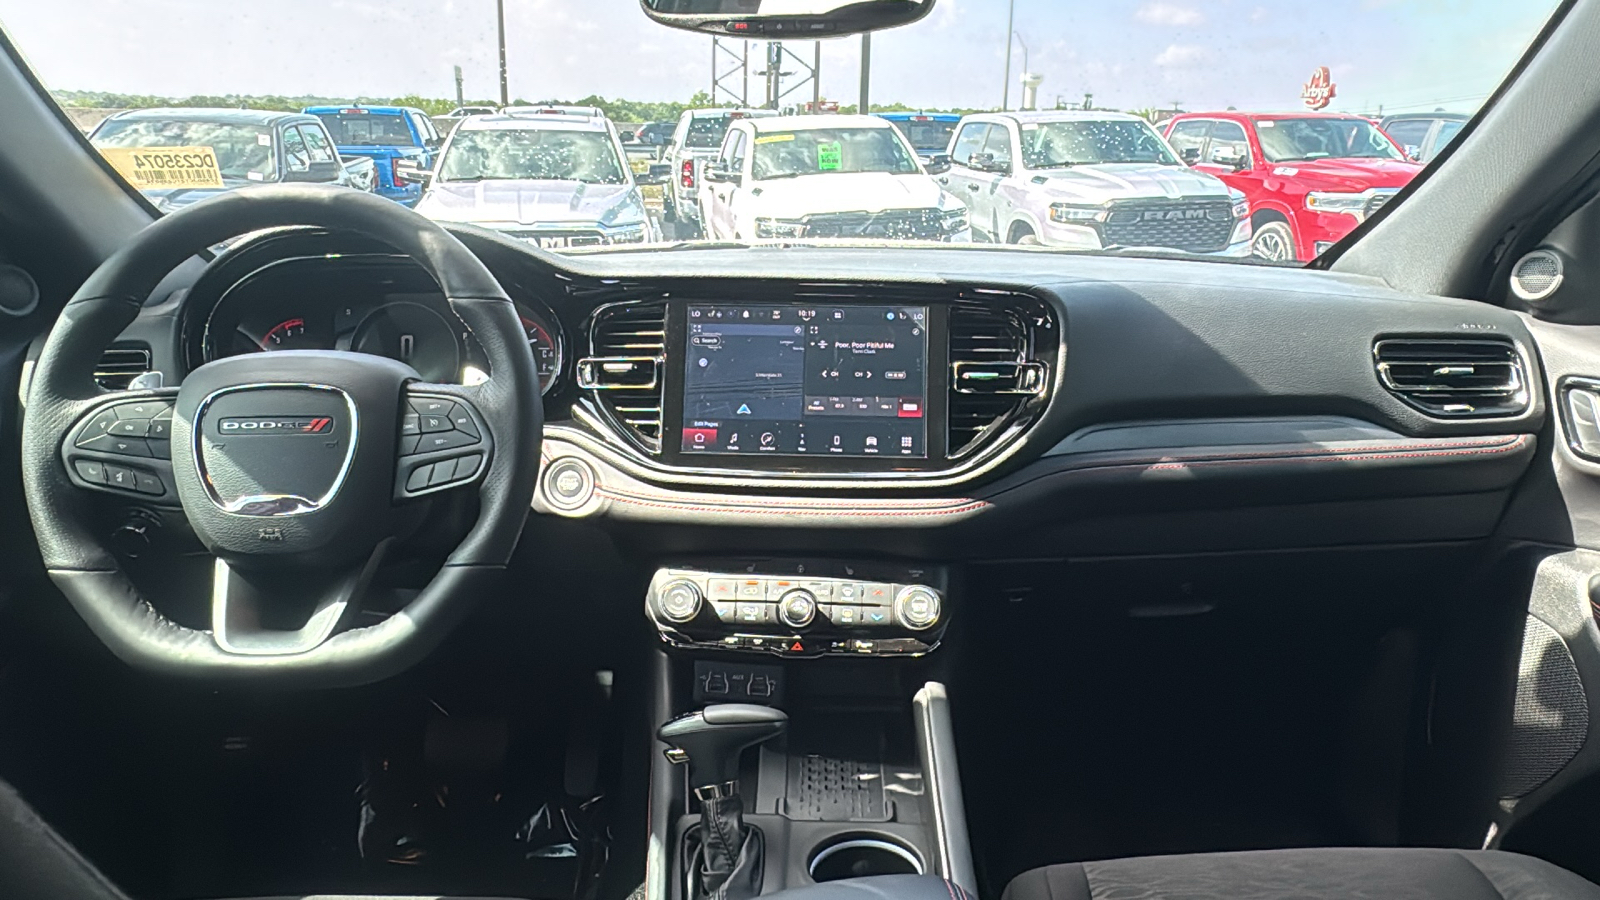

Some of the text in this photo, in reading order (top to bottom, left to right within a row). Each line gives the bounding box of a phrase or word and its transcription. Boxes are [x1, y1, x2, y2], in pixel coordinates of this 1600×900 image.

[1300, 83, 1330, 100] Arby's
[1143, 209, 1205, 220] RAM
[691, 310, 701, 318] LO
[798, 310, 816, 318] 10:19
[400, 334, 414, 360] 0
[851, 341, 866, 349] Poor
[222, 421, 312, 431] DODGE
